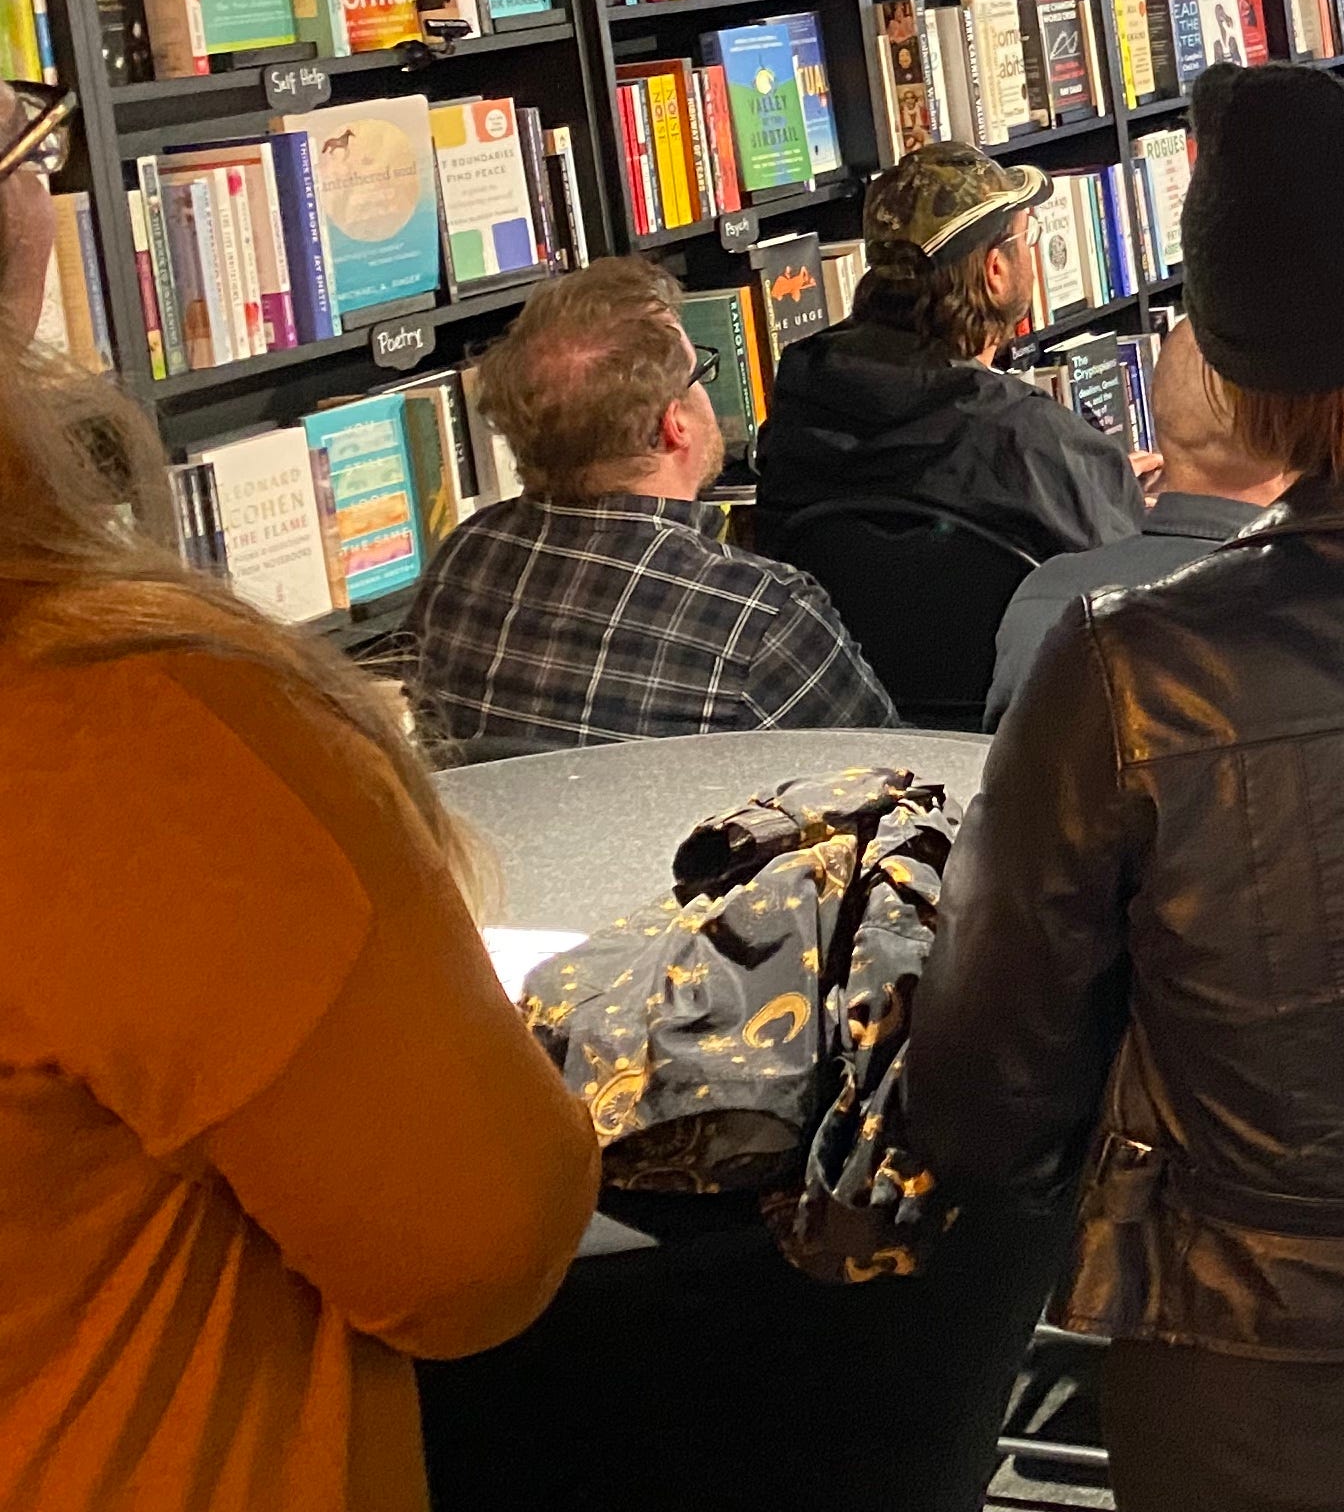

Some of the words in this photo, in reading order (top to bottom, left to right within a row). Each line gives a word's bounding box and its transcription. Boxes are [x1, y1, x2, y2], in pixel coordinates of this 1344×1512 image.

[1173, 2, 1199, 19] EAD
[963, 7, 973, 43] MARK
[999, 57, 1025, 79] abits
[271, 71, 296, 95] Self
[300, 69, 326, 89] Help
[653, 91, 666, 142] NOISE
[751, 94, 788, 113] VALLEY
[299, 141, 309, 175] THINK
[452, 149, 514, 168] BOUNDARIES
[1146, 134, 1185, 160] ROGUES
[393, 161, 417, 177] soul
[475, 165, 507, 180] PEACE
[696, 160, 706, 192] TEARS
[303, 176, 313, 200] LIKE
[309, 210, 319, 243] MONK
[724, 219, 750, 238] Psych
[730, 301, 744, 356] RANGE
[795, 308, 824, 326] URGE
[377, 327, 424, 355] Poetry
[1072, 354, 1089, 369] The
[228, 491, 306, 530] COHEN
[233, 528, 257, 548] THE
[264, 514, 308, 540] FLAME
